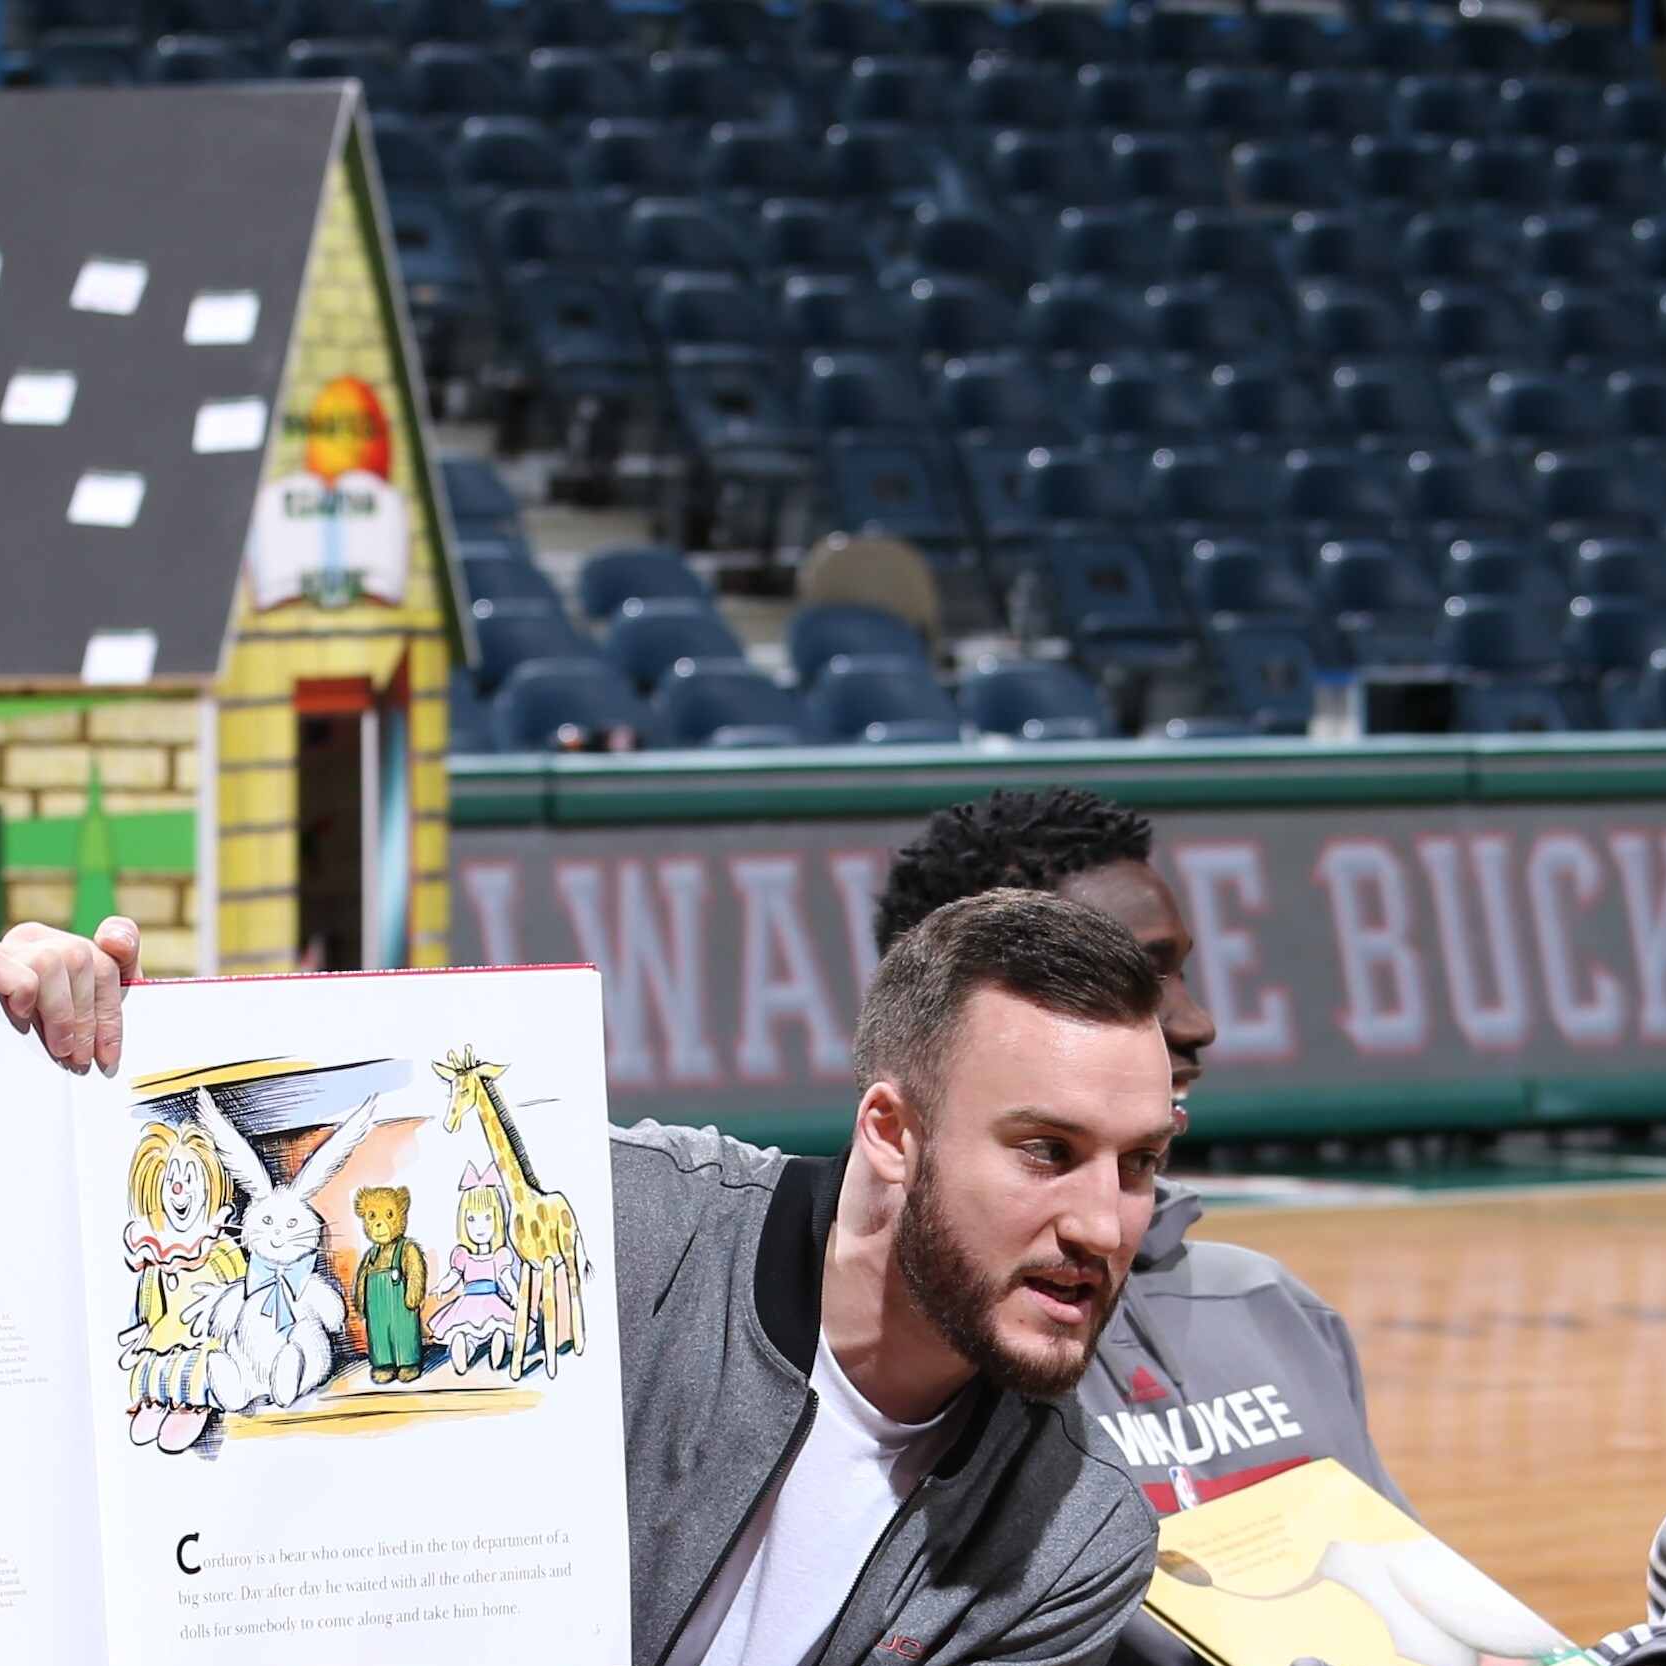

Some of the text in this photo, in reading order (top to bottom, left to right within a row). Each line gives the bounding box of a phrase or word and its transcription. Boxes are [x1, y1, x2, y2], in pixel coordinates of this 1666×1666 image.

[176, 1530, 569, 1574] Corduroy is a bear who once lived in the toy department of a
[178, 1562, 572, 1608] big store. Day after day he waited with all the other animals and
[180, 1602, 520, 1639] dolls for somebody to come along and take him home.
[593, 1624, 601, 1636] 5
